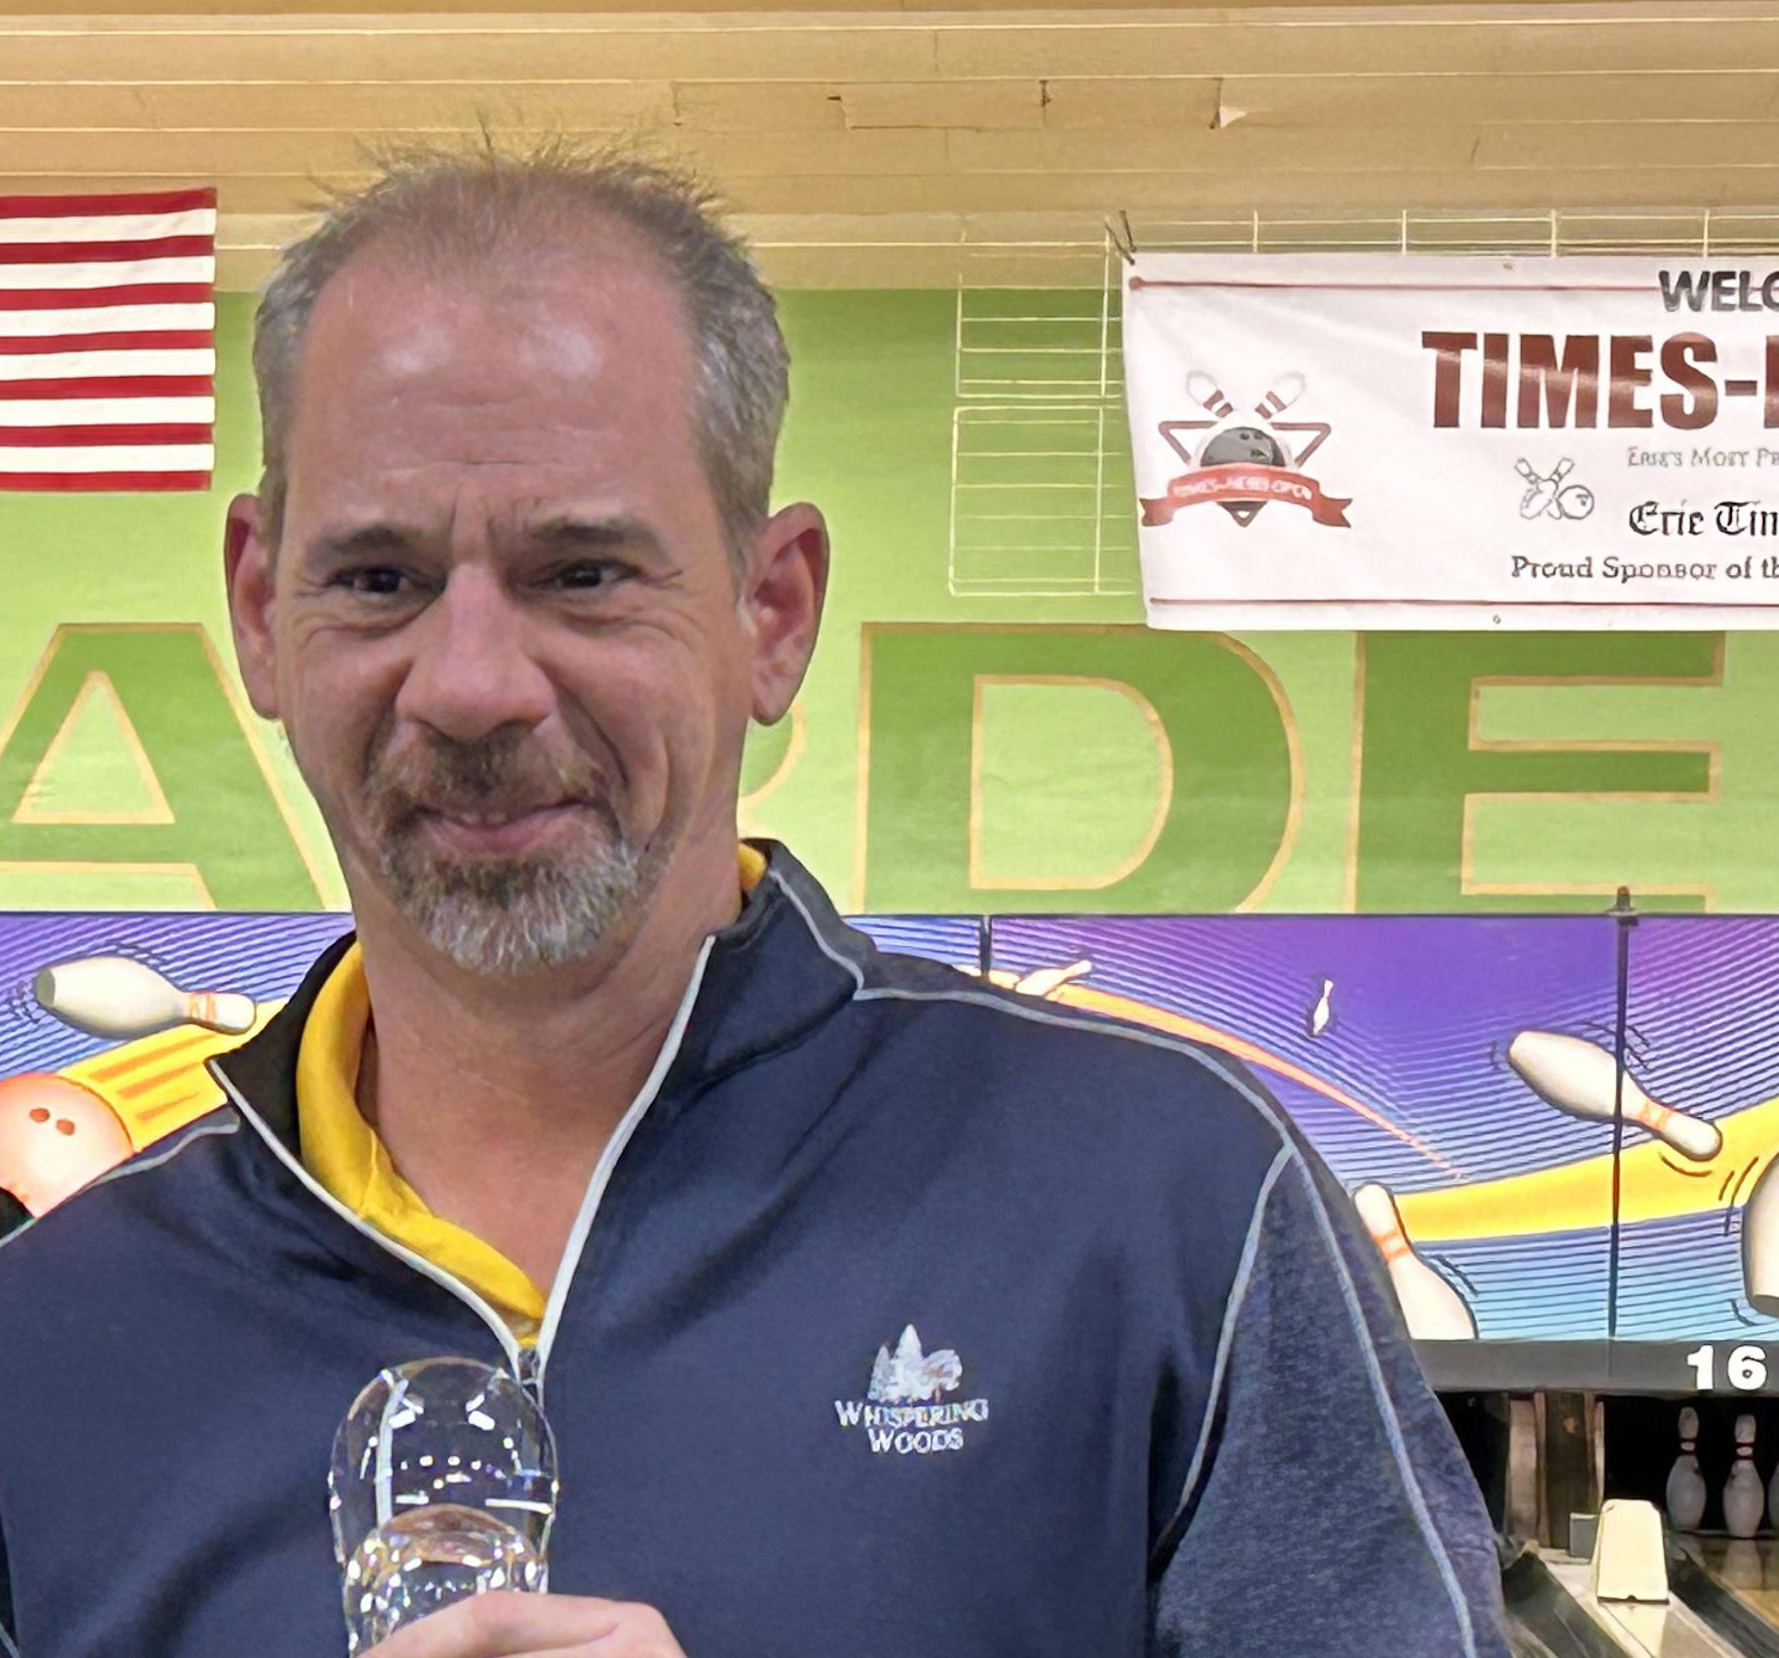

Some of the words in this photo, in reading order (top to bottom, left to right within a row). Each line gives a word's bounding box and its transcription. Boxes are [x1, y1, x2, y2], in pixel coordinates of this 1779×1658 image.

[1422, 331, 1779, 430] TIMES-
[1629, 499, 1704, 536] Erie
[1511, 555, 1593, 578] Proud
[1602, 556, 1717, 584] Sponsor
[1726, 556, 1752, 579] of
[1687, 1345, 1767, 1390] 16
[868, 1427, 964, 1454] WOODS
